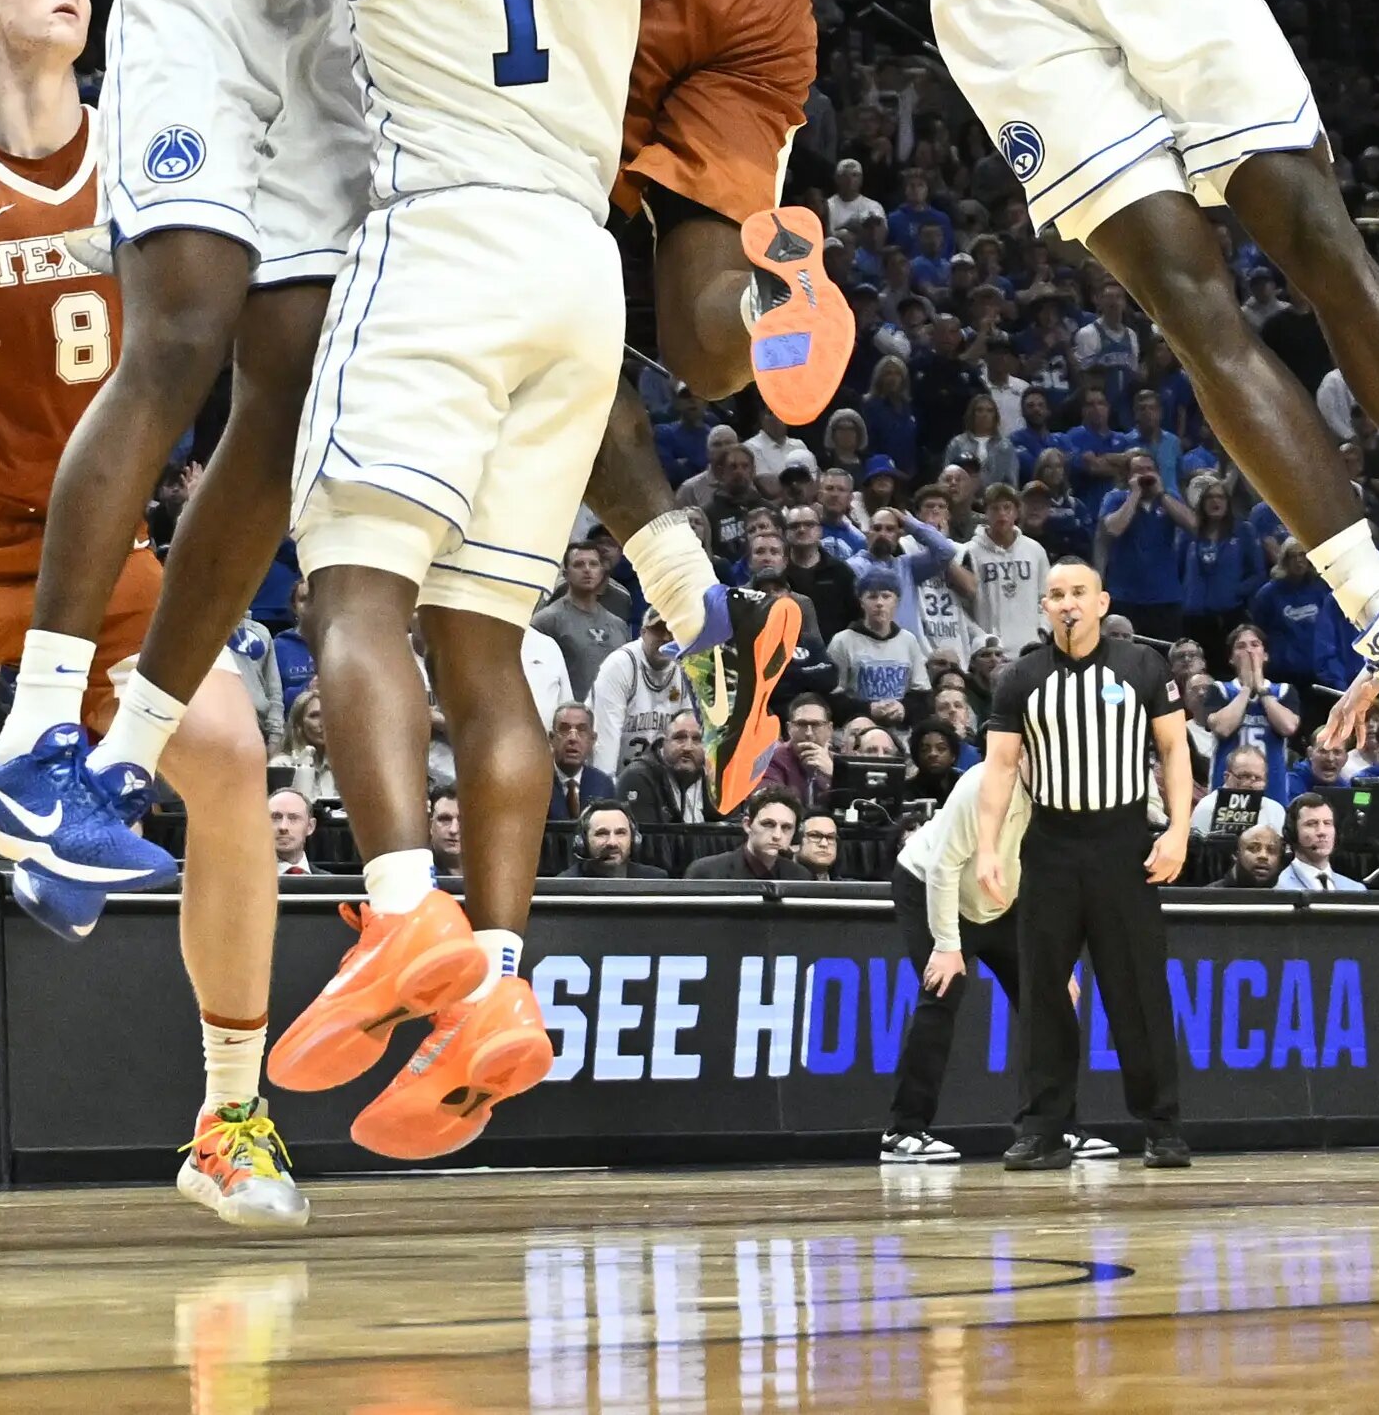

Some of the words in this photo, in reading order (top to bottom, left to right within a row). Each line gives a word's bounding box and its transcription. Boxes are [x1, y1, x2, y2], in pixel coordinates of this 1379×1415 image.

[51, 290, 112, 386] 8
[982, 559, 1032, 584] BYU
[923, 592, 954, 617] 32
[1229, 793, 1251, 811] DV
[533, 955, 706, 1080] SEE
[1165, 958, 1368, 1069] NCAA
